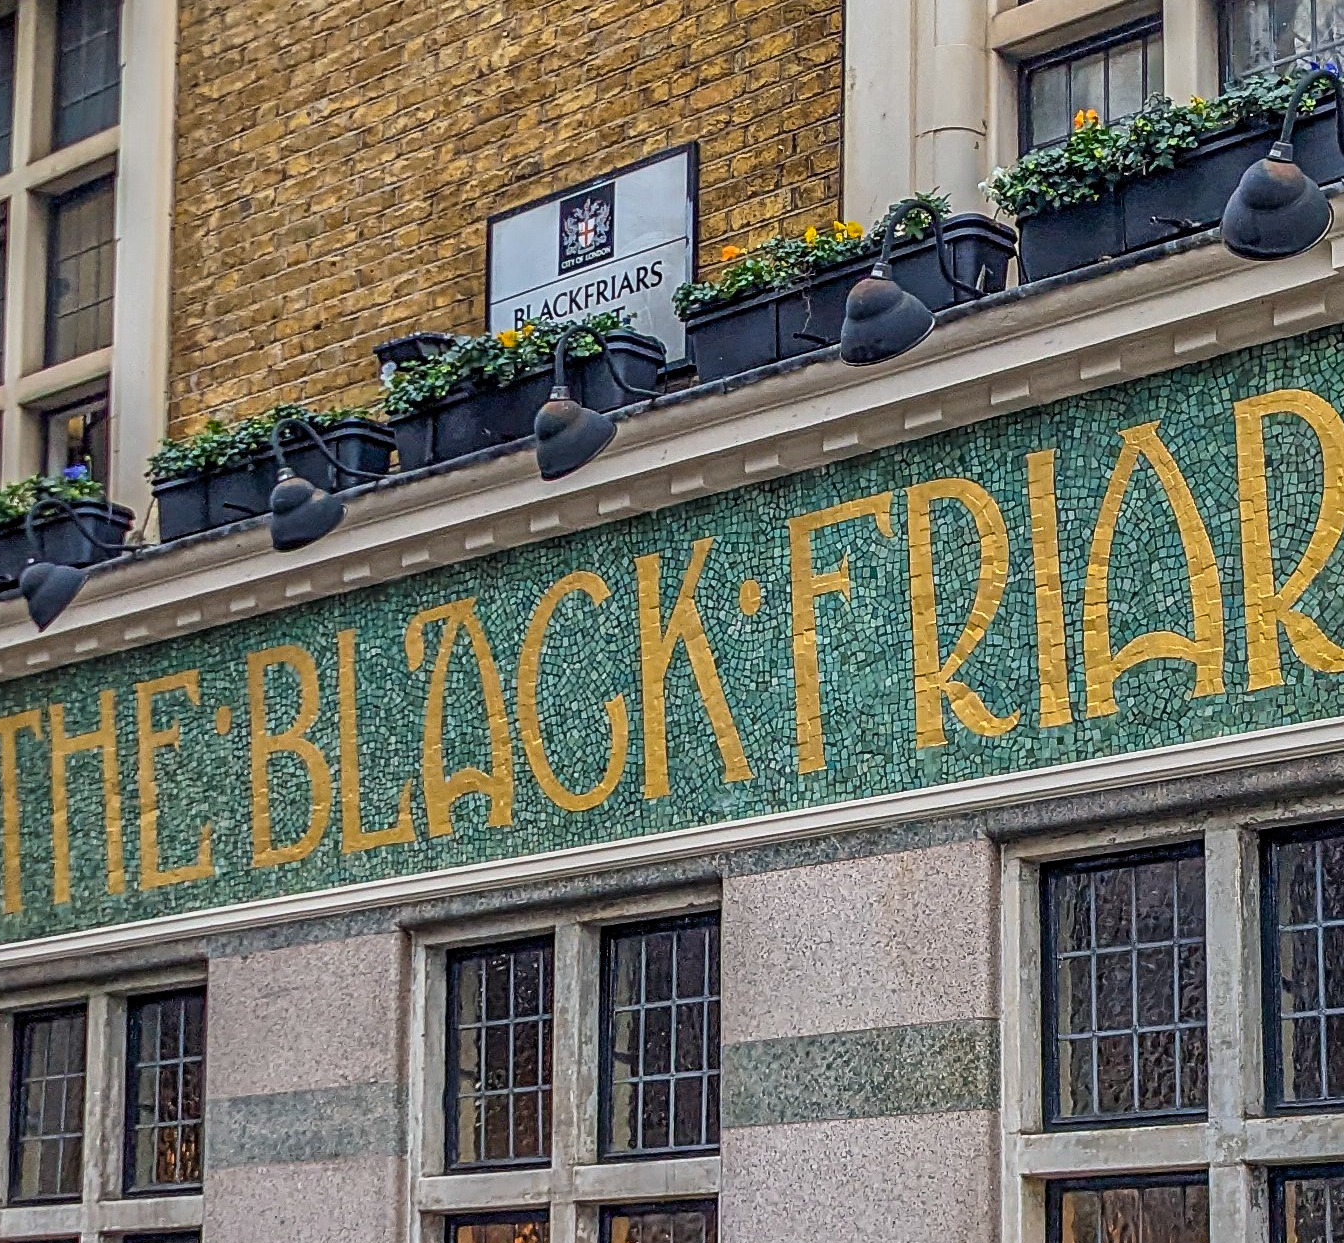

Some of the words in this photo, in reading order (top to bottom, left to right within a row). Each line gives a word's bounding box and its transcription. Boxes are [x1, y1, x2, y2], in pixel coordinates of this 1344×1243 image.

[561, 259, 574, 269] CITY
[576, 255, 584, 264] OF
[585, 246, 611, 260] LONDON
[514, 260, 663, 331] BLACKFRIARS
[246, 536, 755, 868] BLACK
